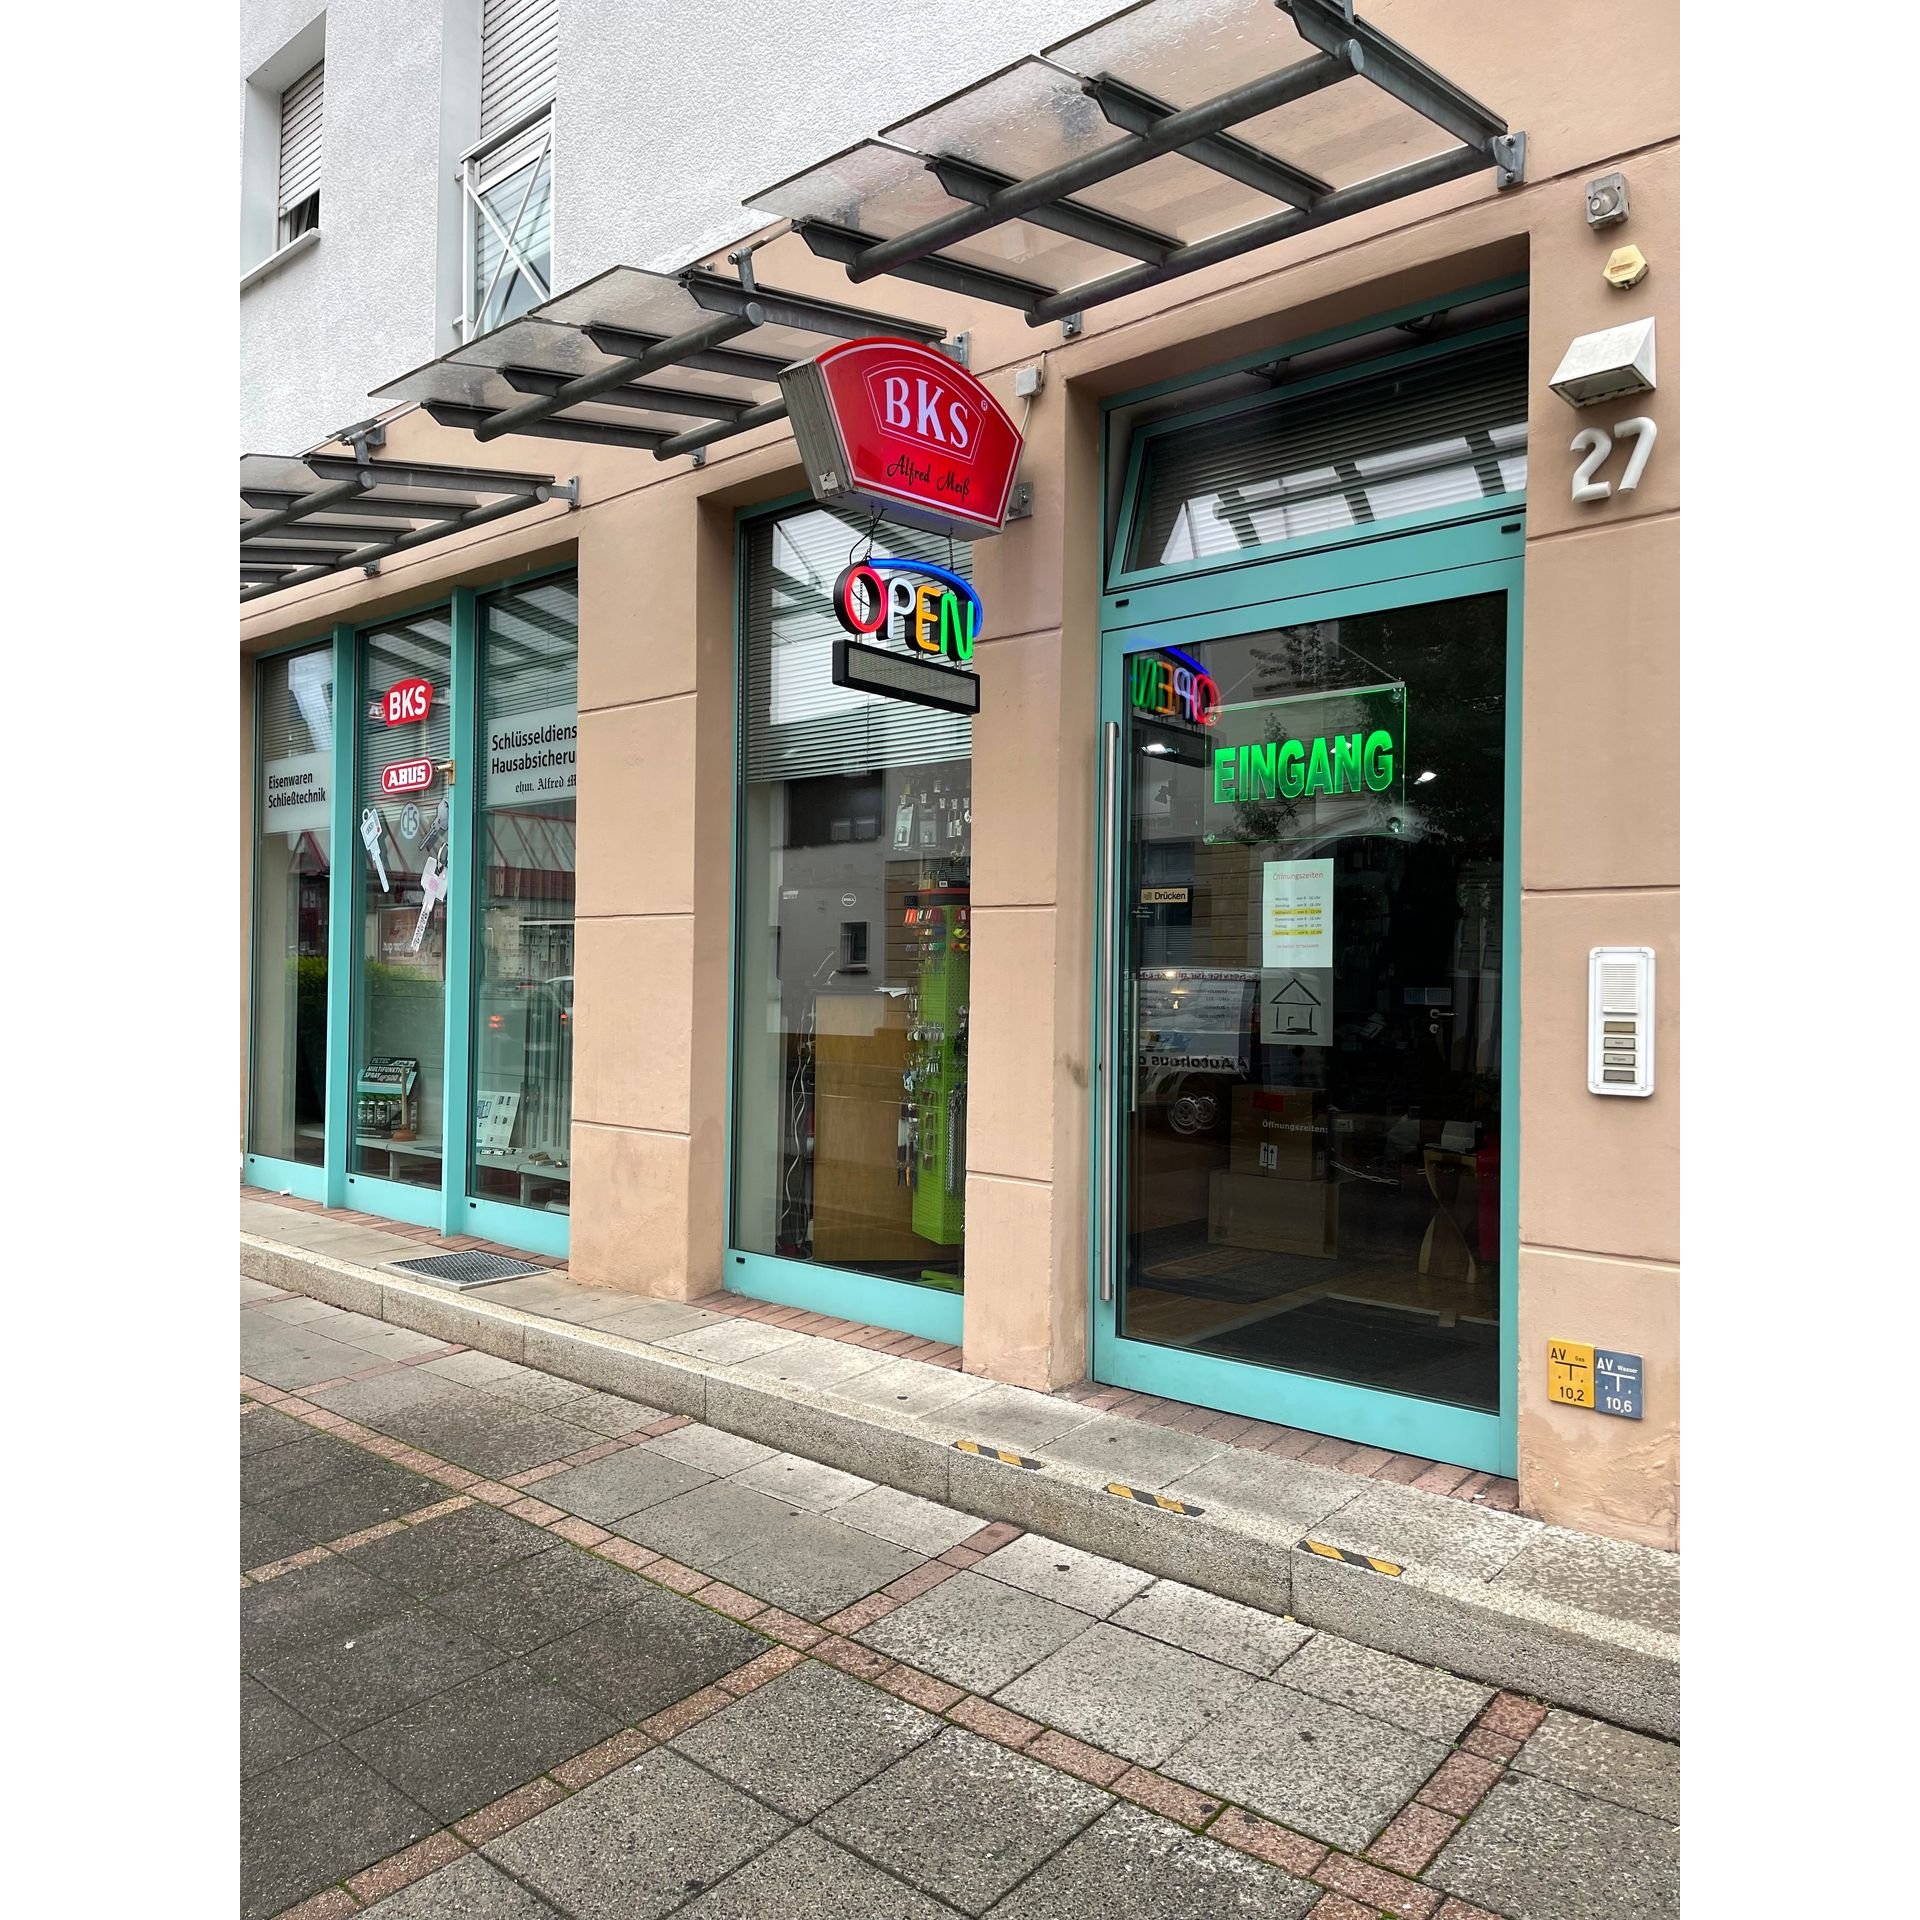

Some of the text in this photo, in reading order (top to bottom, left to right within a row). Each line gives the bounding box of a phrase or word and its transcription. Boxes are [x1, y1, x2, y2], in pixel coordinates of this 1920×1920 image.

[884, 377, 968, 449] BKS
[1570, 416, 1657, 502] 27
[886, 454, 970, 503] Alfred Meiß
[843, 565, 974, 660] OPEN
[389, 685, 427, 721] BKS
[492, 724, 577, 751] Schlüsseldiens
[492, 749, 576, 775] Hausabsicheru
[1214, 729, 1393, 804] EINGANG
[268, 772, 313, 790] Eisenwaren
[387, 765, 426, 788] ABUS
[537, 775, 565, 791] Alfred
[268, 787, 326, 809] Schließtechnik
[401, 806, 418, 836] CES
[1272, 871, 1324, 881] Öffnungszeiten
[1154, 891, 1186, 901] Drücken
[1550, 1347, 1567, 1361] AV
[1597, 1357, 1639, 1374] AV Wasser
[1560, 1386, 1585, 1402] 10,2
[1606, 1396, 1632, 1413] 10,6
